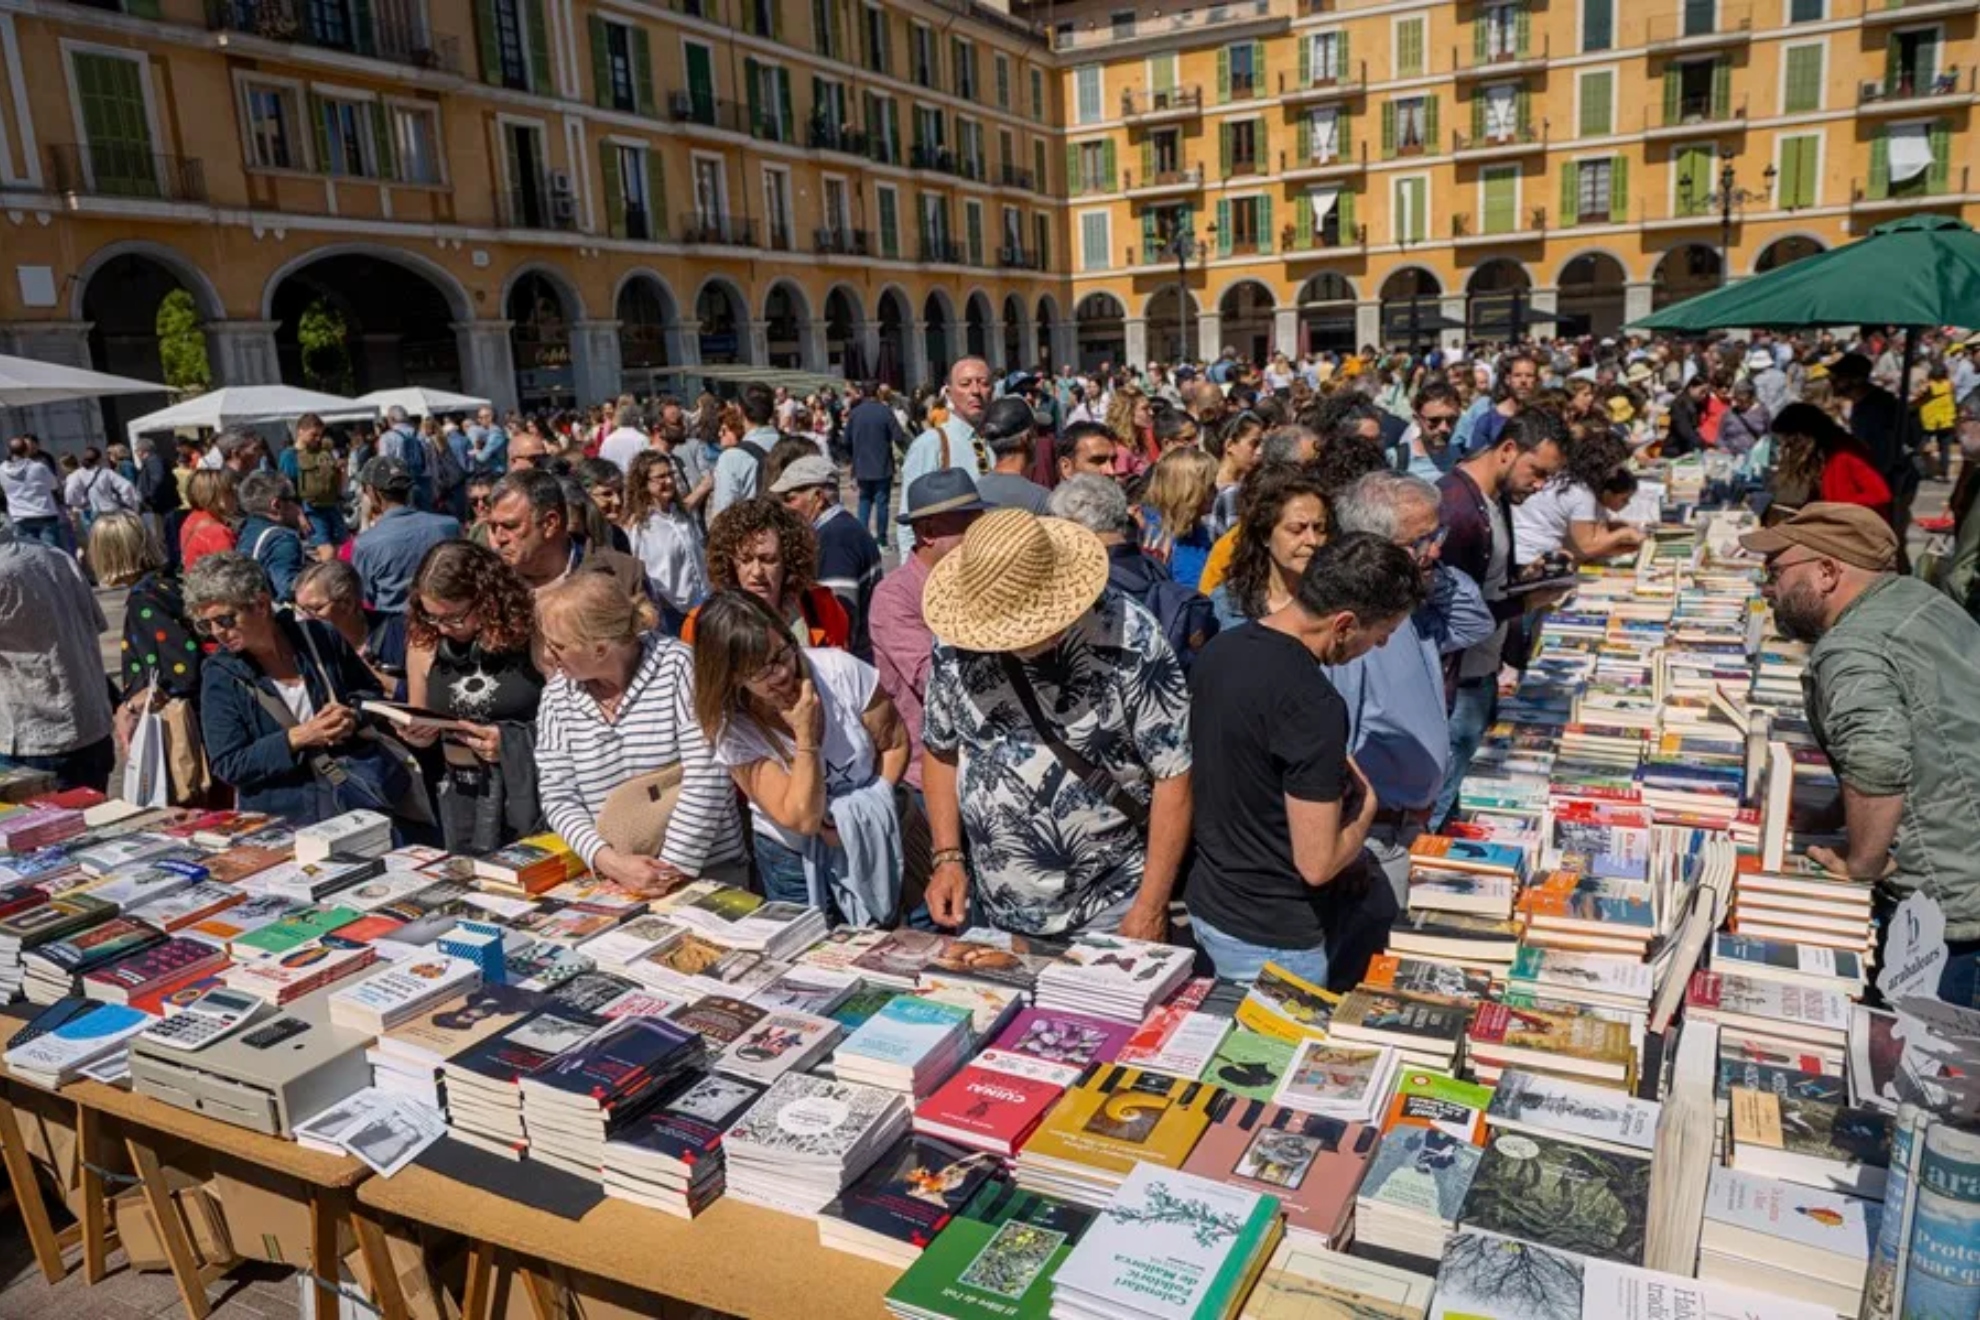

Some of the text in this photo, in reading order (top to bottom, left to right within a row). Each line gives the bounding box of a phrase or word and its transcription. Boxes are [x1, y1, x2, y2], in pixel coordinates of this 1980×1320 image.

[1114, 1254, 1177, 1279] Mallorca
[1113, 1277, 1187, 1307] Calendari
[1179, 1275, 1199, 1285] de
